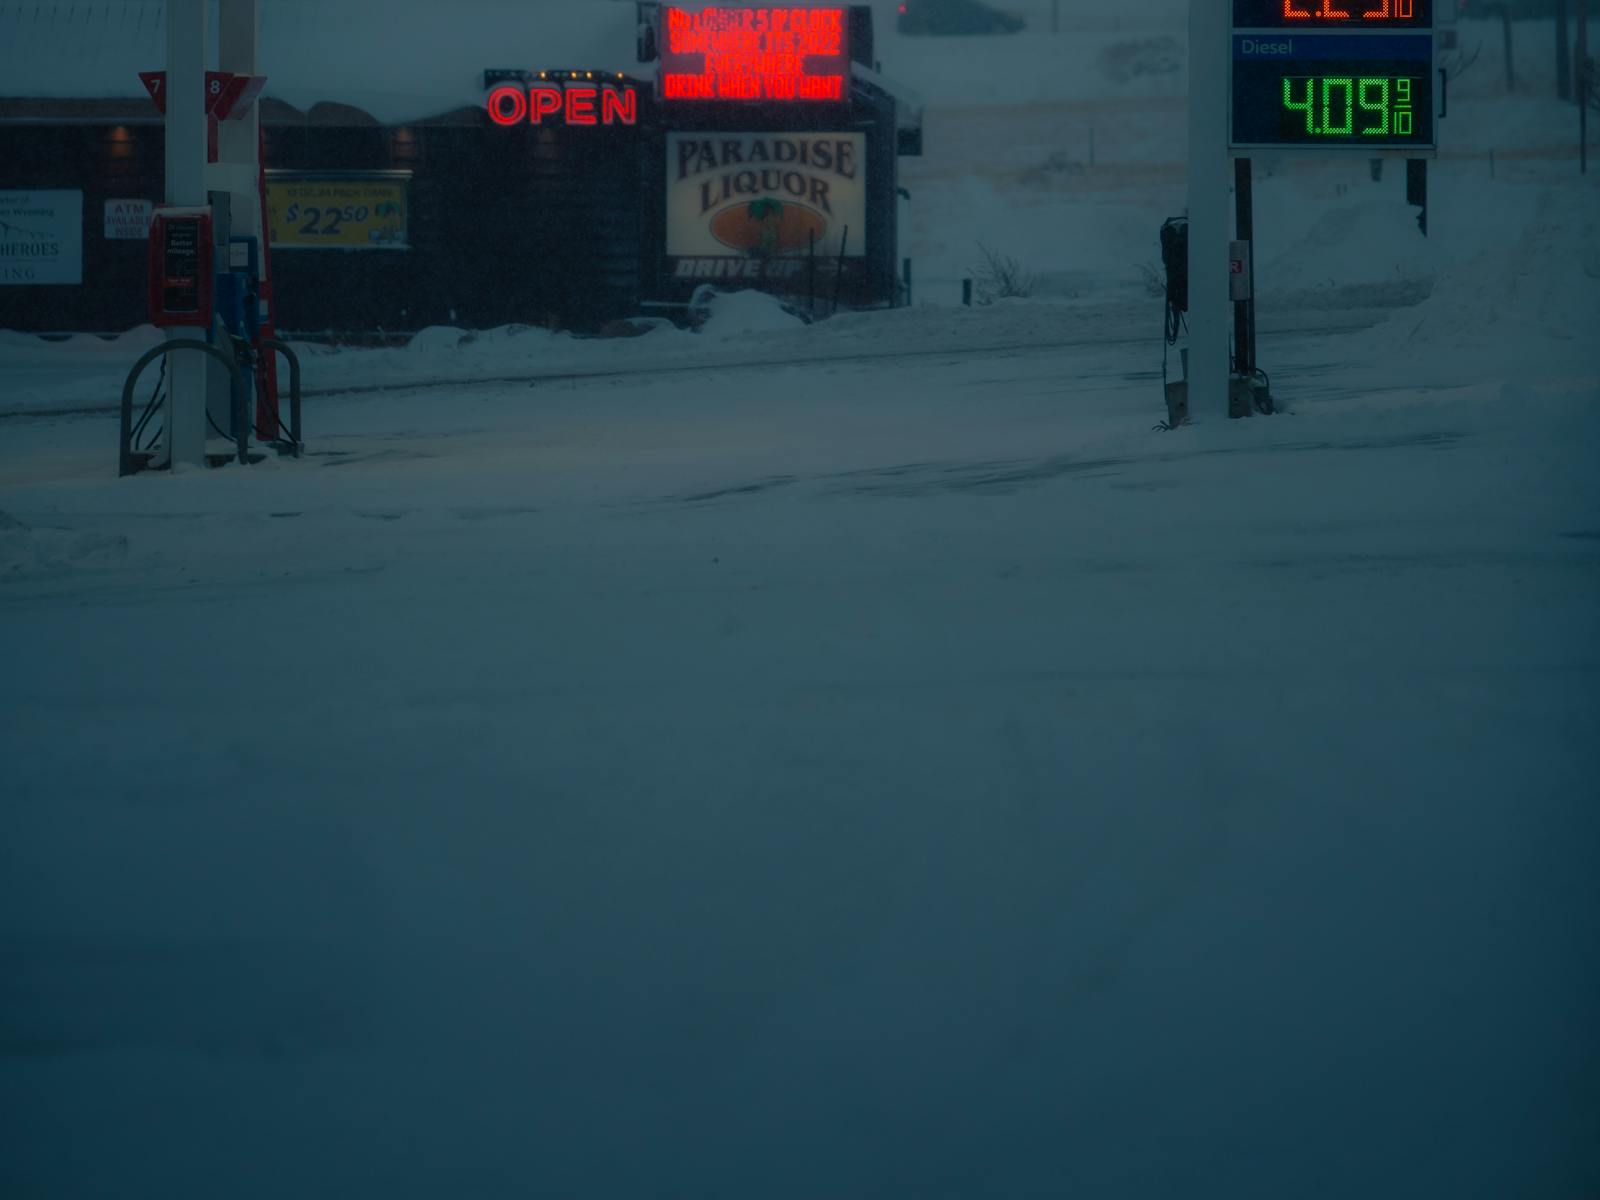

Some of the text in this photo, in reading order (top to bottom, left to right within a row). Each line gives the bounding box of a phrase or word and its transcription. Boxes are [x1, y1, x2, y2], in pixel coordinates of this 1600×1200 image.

[1242, 39, 1293, 55] Diesel
[150, 79, 161, 94] 7
[210, 79, 220, 94] 8
[763, 75, 796, 99] YOU
[488, 83, 636, 126] OPEN
[1283, 78, 1389, 135] 4.09
[676, 139, 858, 182] PARADISE
[699, 169, 835, 220] LIQUOR
[114, 204, 144, 215] ATM
[674, 258, 763, 277] DRIVE
